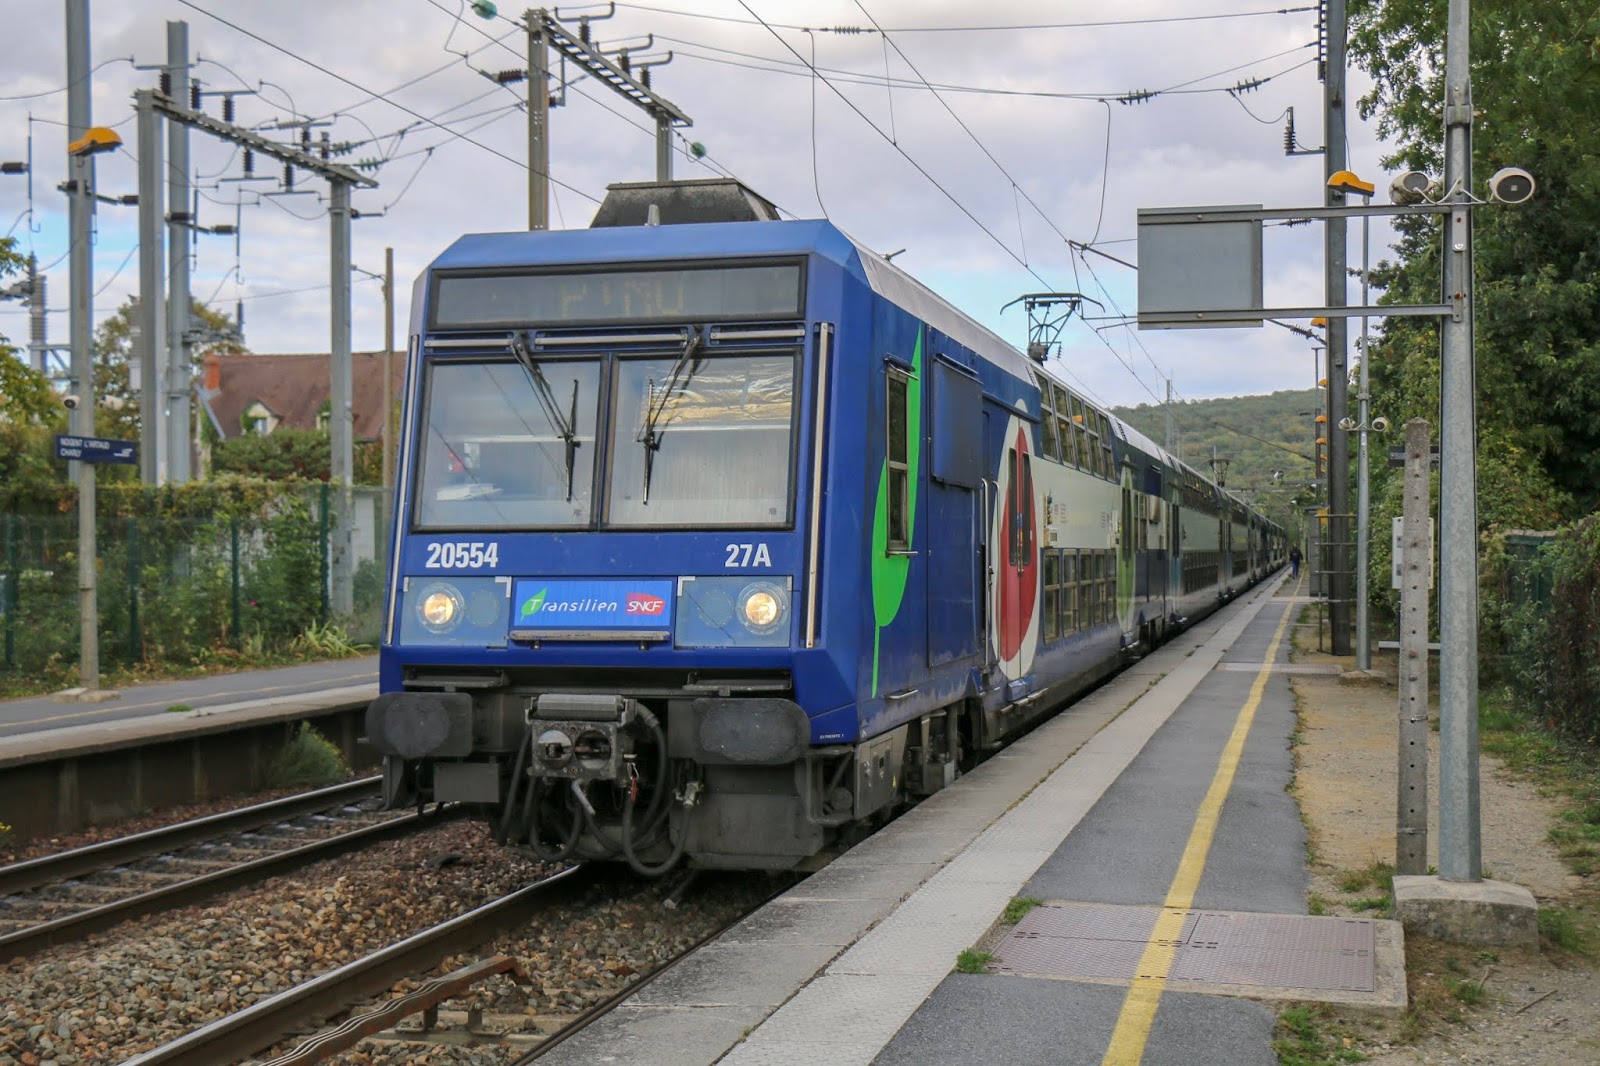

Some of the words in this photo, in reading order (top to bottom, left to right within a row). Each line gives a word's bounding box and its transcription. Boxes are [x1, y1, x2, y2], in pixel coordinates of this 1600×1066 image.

[60, 438, 83, 447] NOGENT
[84, 440, 110, 450] L'ARTAUD
[60, 448, 82, 458] CHARLY
[425, 542, 499, 568] 20554
[725, 543, 772, 567] 27A
[529, 598, 618, 612] Transilien
[626, 600, 663, 612] SNCF
